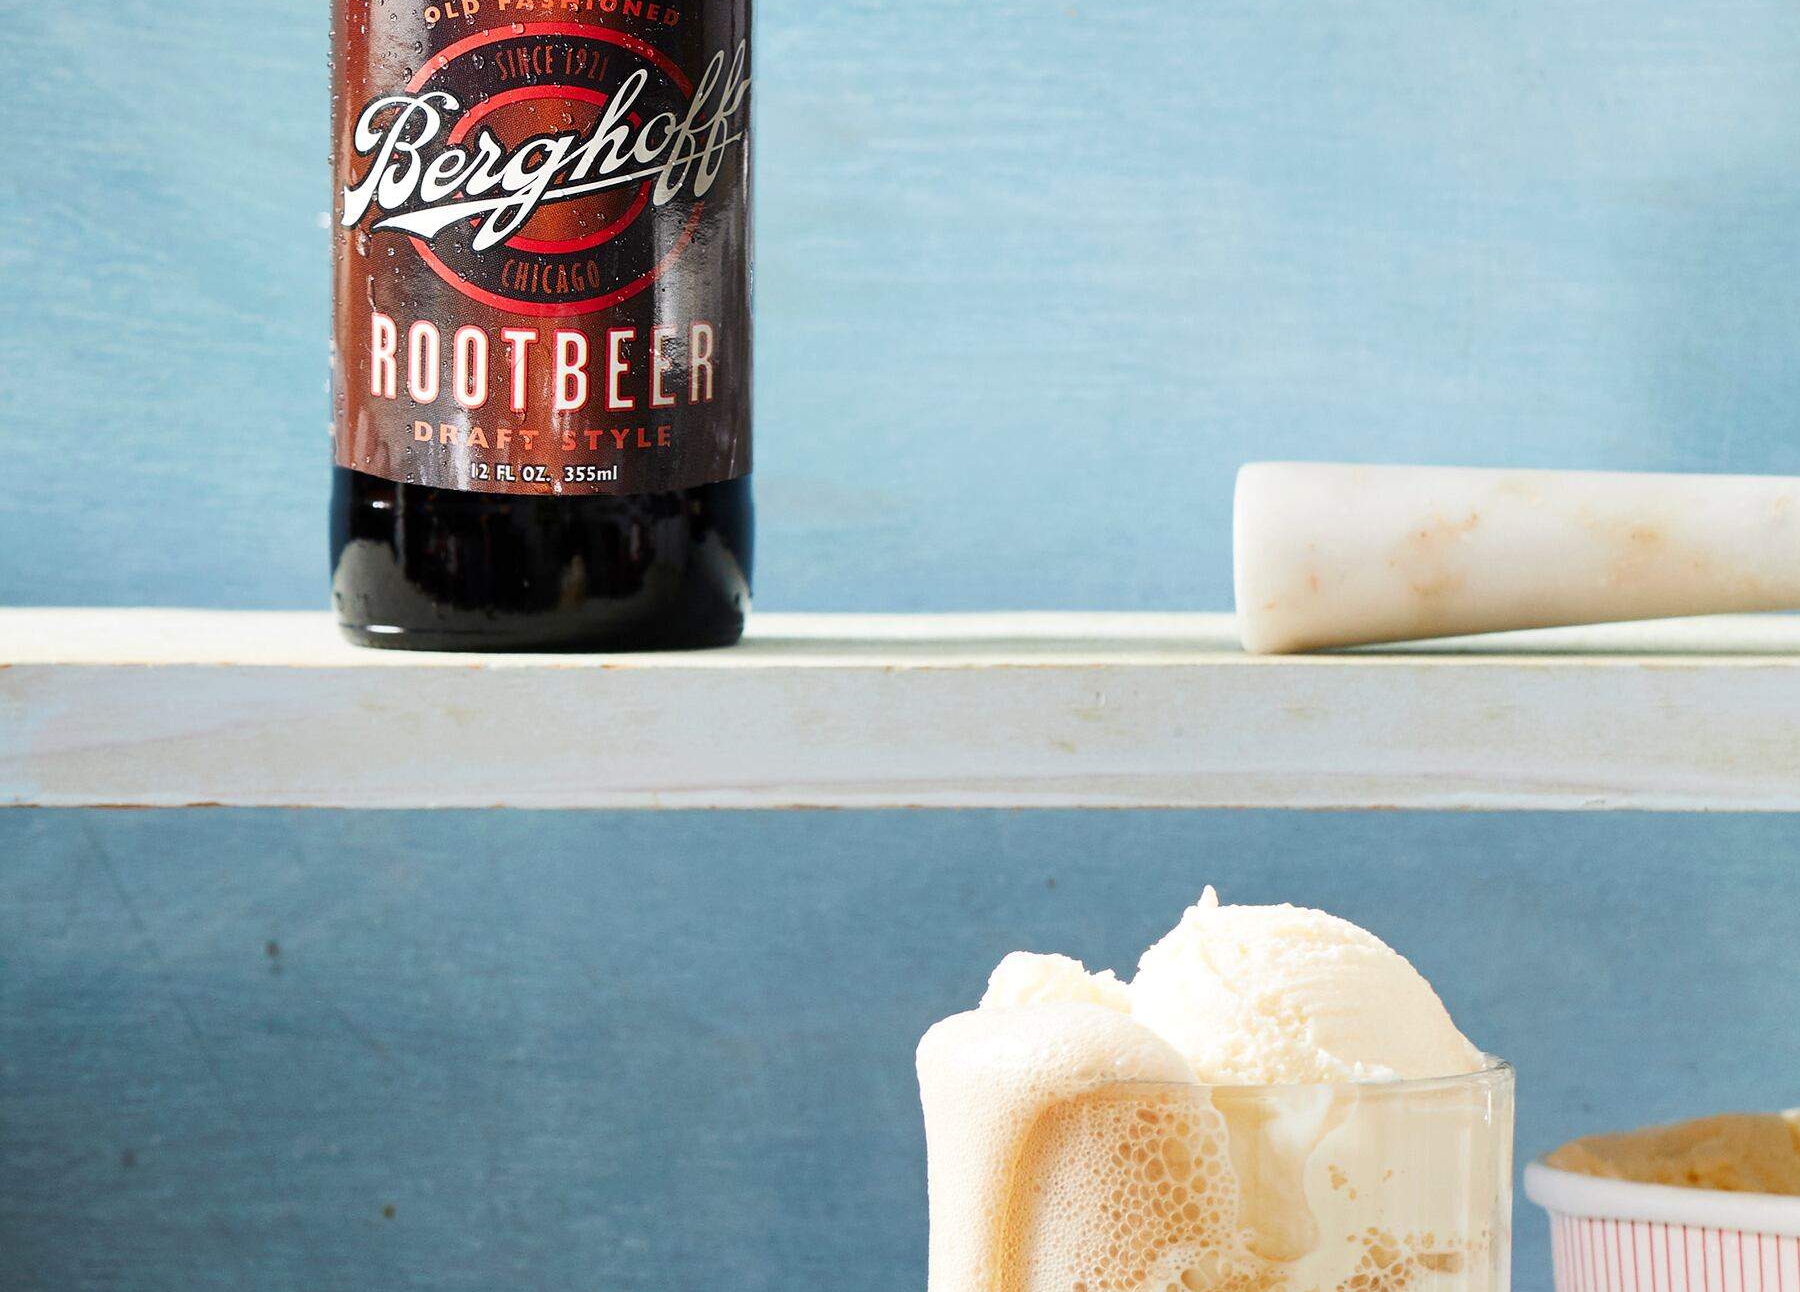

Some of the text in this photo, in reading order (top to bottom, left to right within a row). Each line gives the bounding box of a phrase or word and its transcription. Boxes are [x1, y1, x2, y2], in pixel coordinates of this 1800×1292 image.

[495, 45, 609, 81] SINCE 1921
[342, 39, 752, 252] Berghoff
[501, 259, 601, 295] CHICAGO
[414, 418, 673, 451] DRAFT STYLE
[471, 462, 618, 483] 12 FL OZ. 355ml
